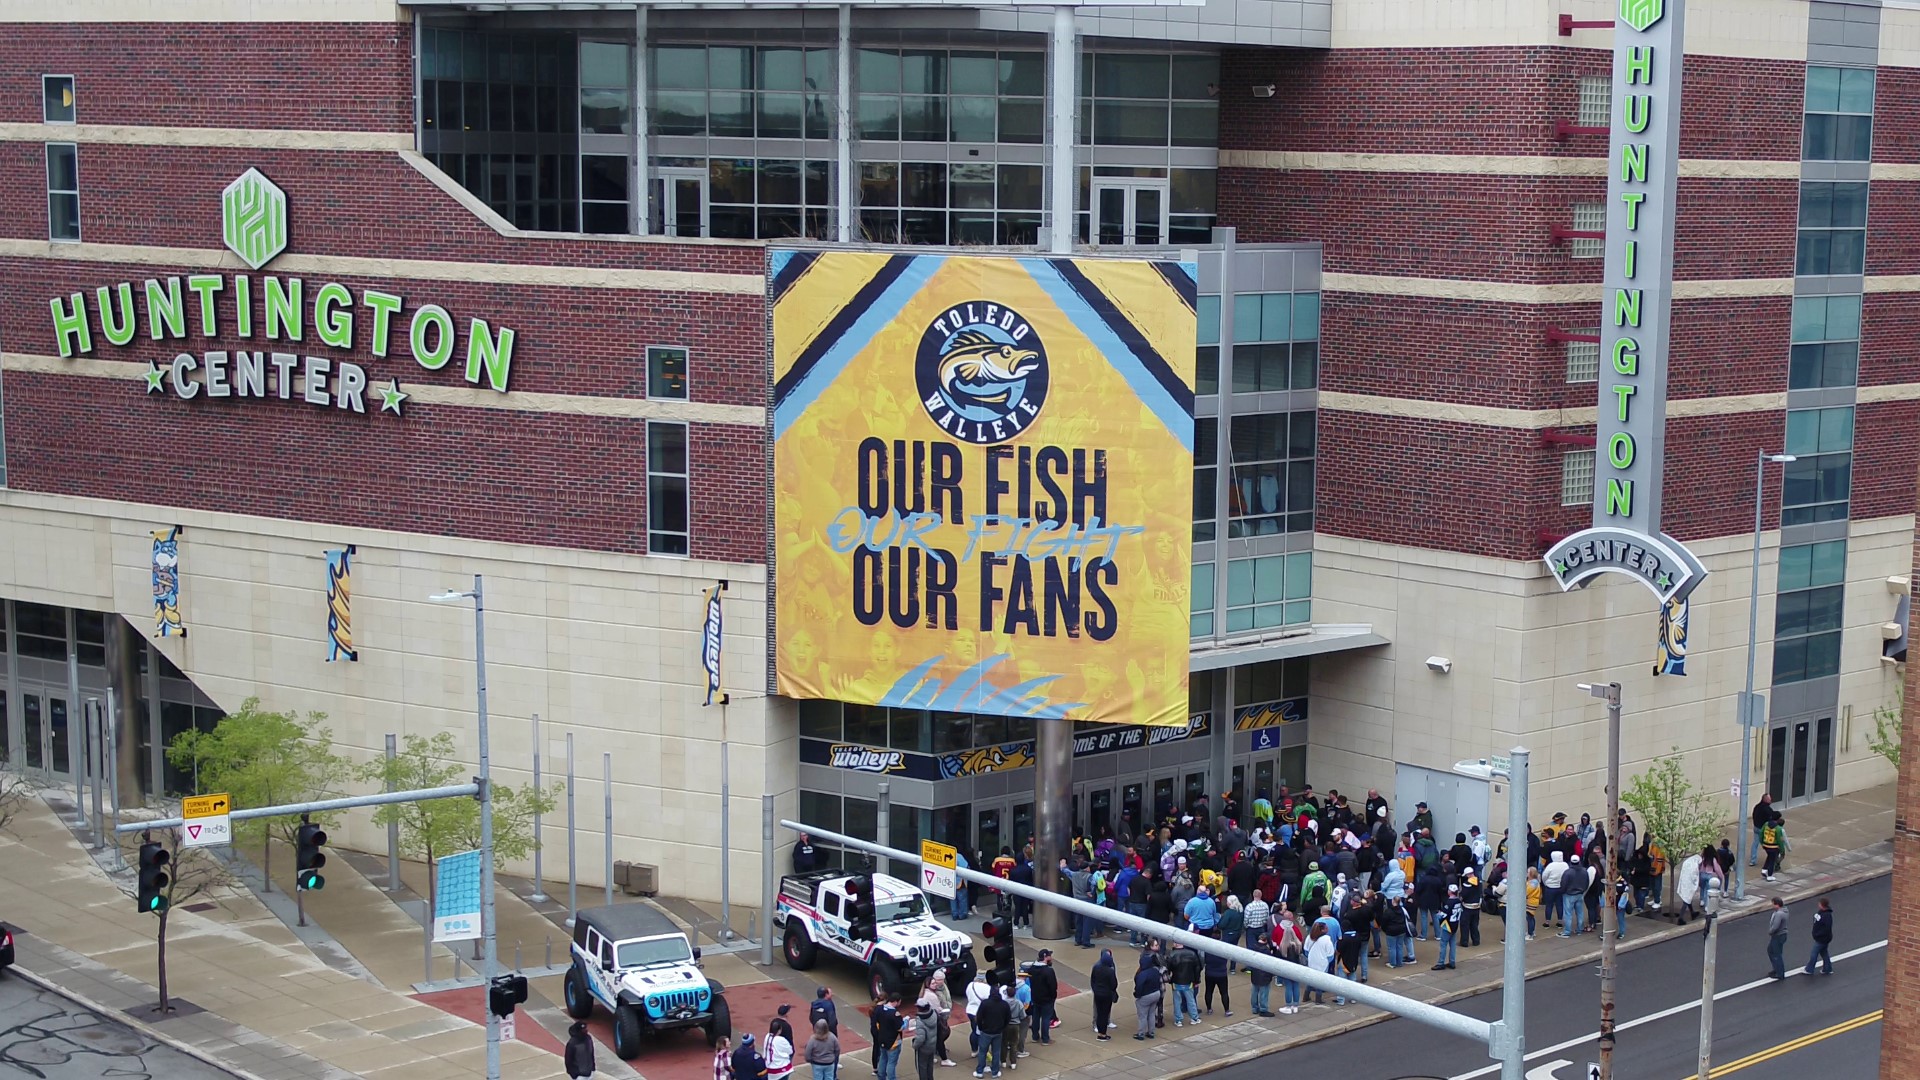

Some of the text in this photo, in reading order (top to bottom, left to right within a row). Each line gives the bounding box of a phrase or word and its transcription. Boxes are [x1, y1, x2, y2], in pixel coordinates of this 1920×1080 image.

[1606, 46, 1652, 516] HUNTINGTON
[50, 274, 515, 393] HUNTINGTON
[934, 304, 1029, 340] TOLEDO
[172, 351, 366, 413] CENTER
[925, 391, 1039, 442] WALLEYE
[857, 436, 1108, 531] OUR FISH
[826, 506, 1145, 573] OUR FIGHT
[1565, 540, 1658, 577] CENTER
[853, 543, 1118, 641] OUR FANS
[833, 751, 900, 771] Walleye
[1073, 736, 1097, 752] OME
[1099, 733, 1117, 748] OF
[1119, 729, 1142, 746] THE
[1002, 868, 1010, 880] 5
